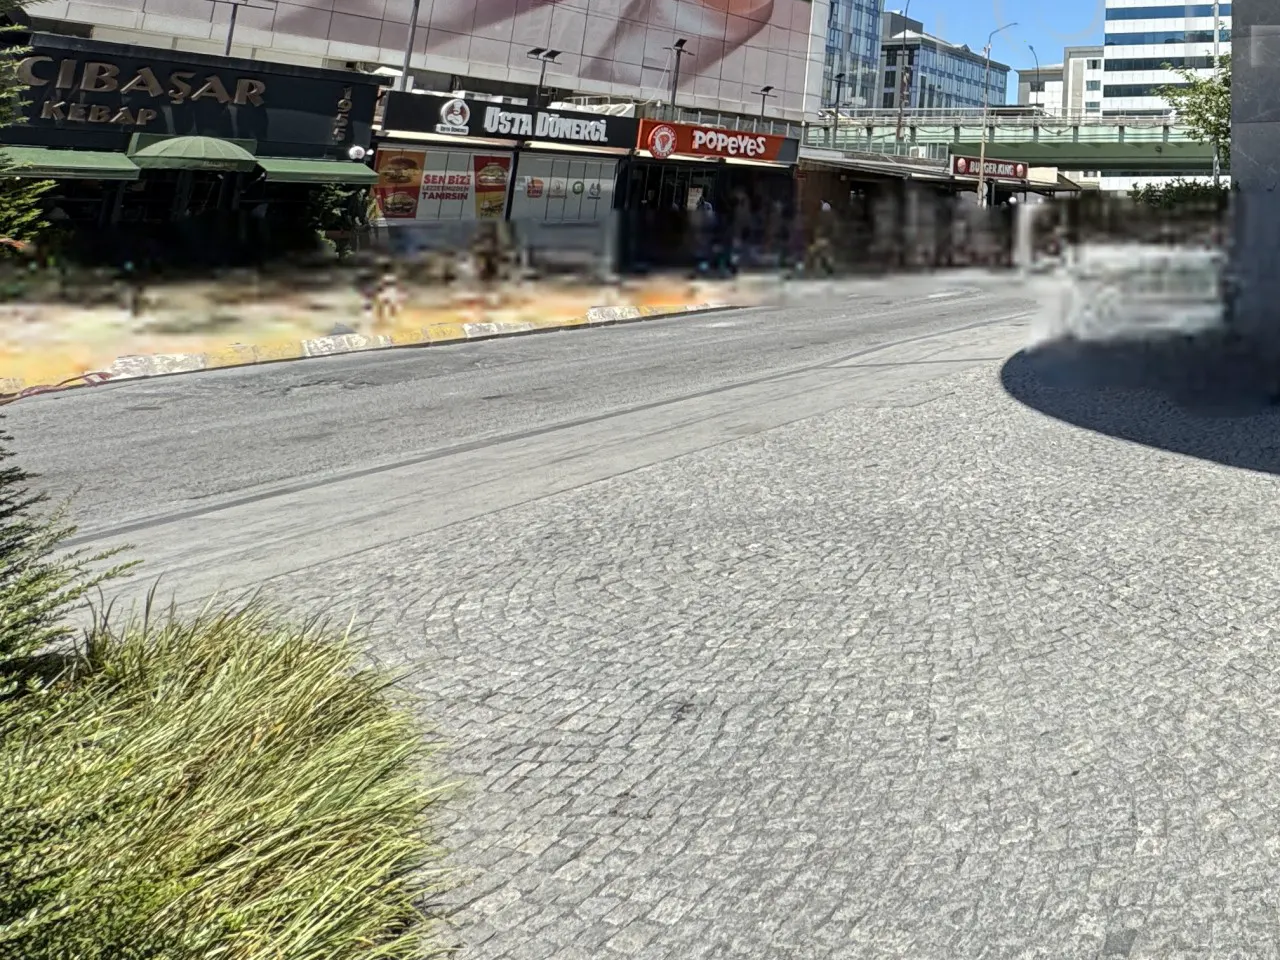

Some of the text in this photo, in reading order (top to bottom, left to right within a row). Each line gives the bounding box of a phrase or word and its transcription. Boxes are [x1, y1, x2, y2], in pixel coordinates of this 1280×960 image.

[40, 100, 157, 125] KEBAP
[483, 106, 533, 136] USTA
[969, 161, 997, 174] BUGER
[424, 174, 446, 184] SEN
[422, 191, 468, 200] TANIRSIN
